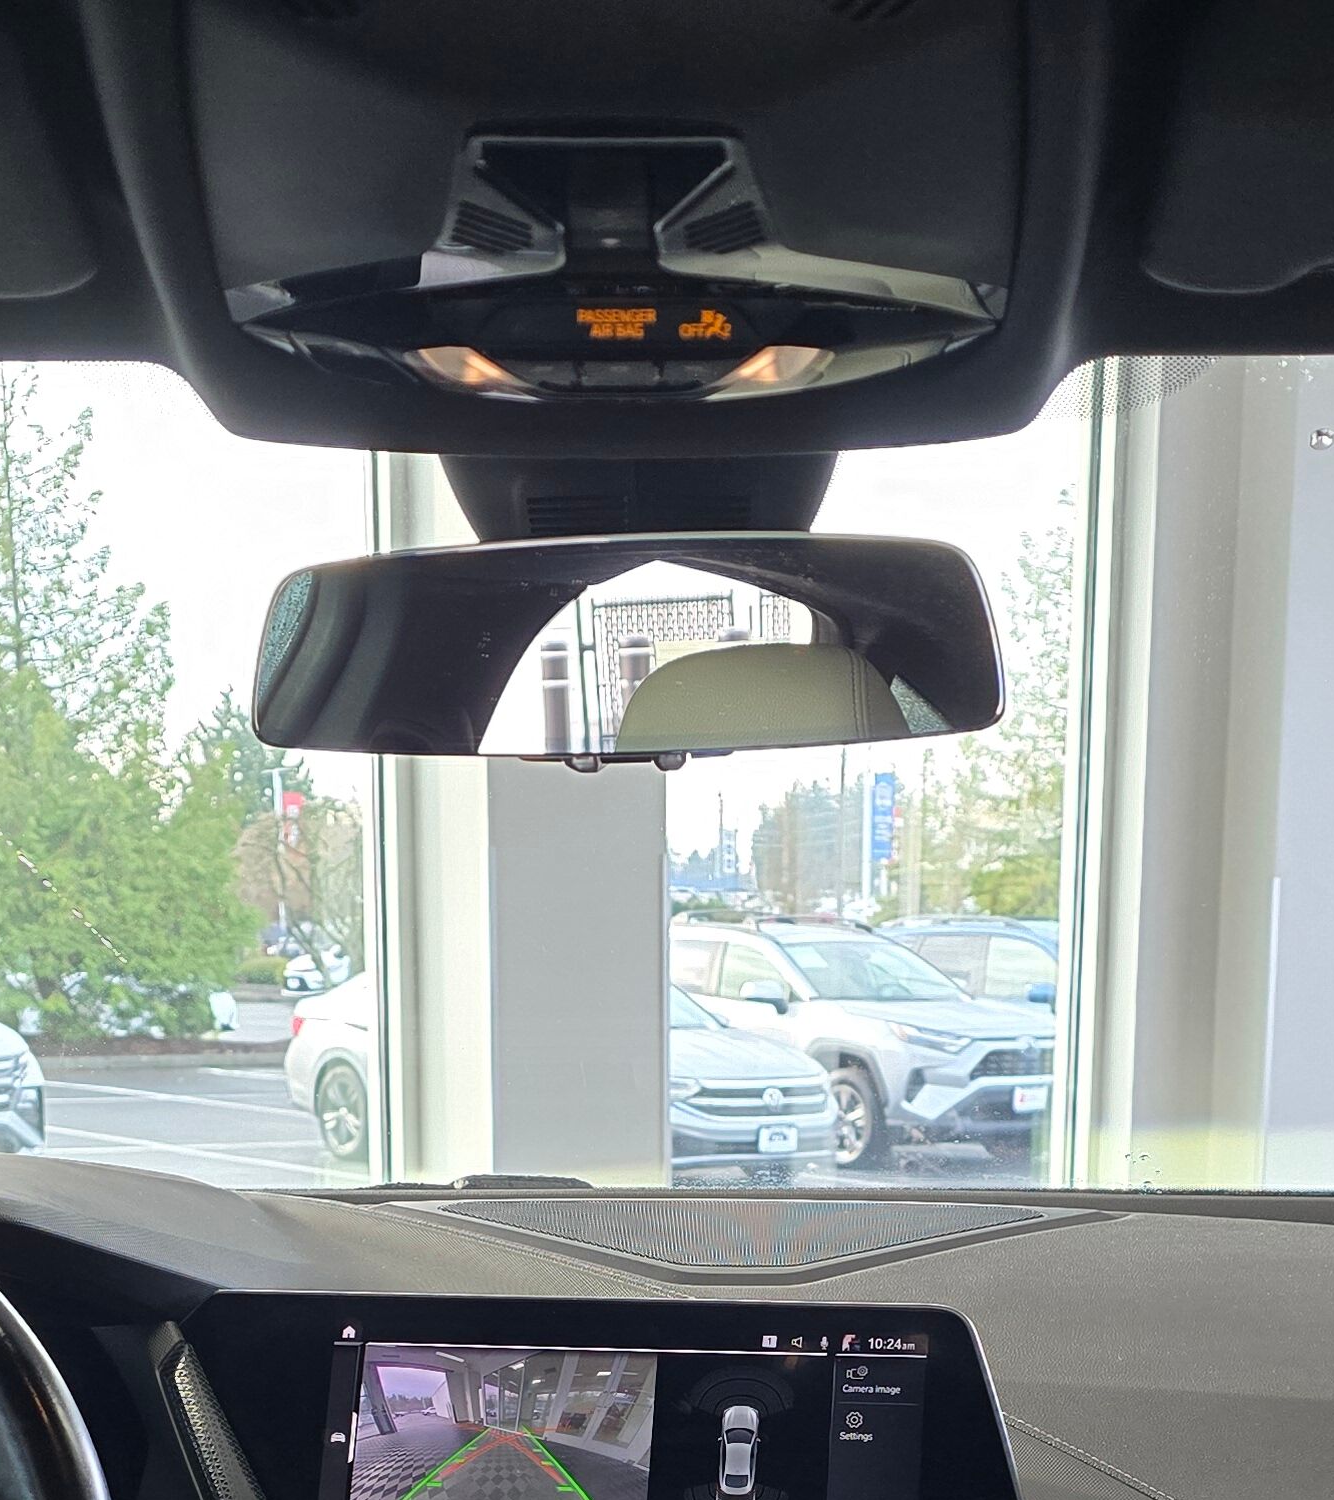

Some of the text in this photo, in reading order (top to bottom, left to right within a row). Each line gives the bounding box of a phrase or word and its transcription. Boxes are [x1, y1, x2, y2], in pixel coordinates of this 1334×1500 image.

[576, 309, 657, 323] PASSENGER
[590, 324, 645, 339] AIR BAG
[842, 1384, 902, 1396] Camera image
[838, 1431, 874, 1443] Settings
